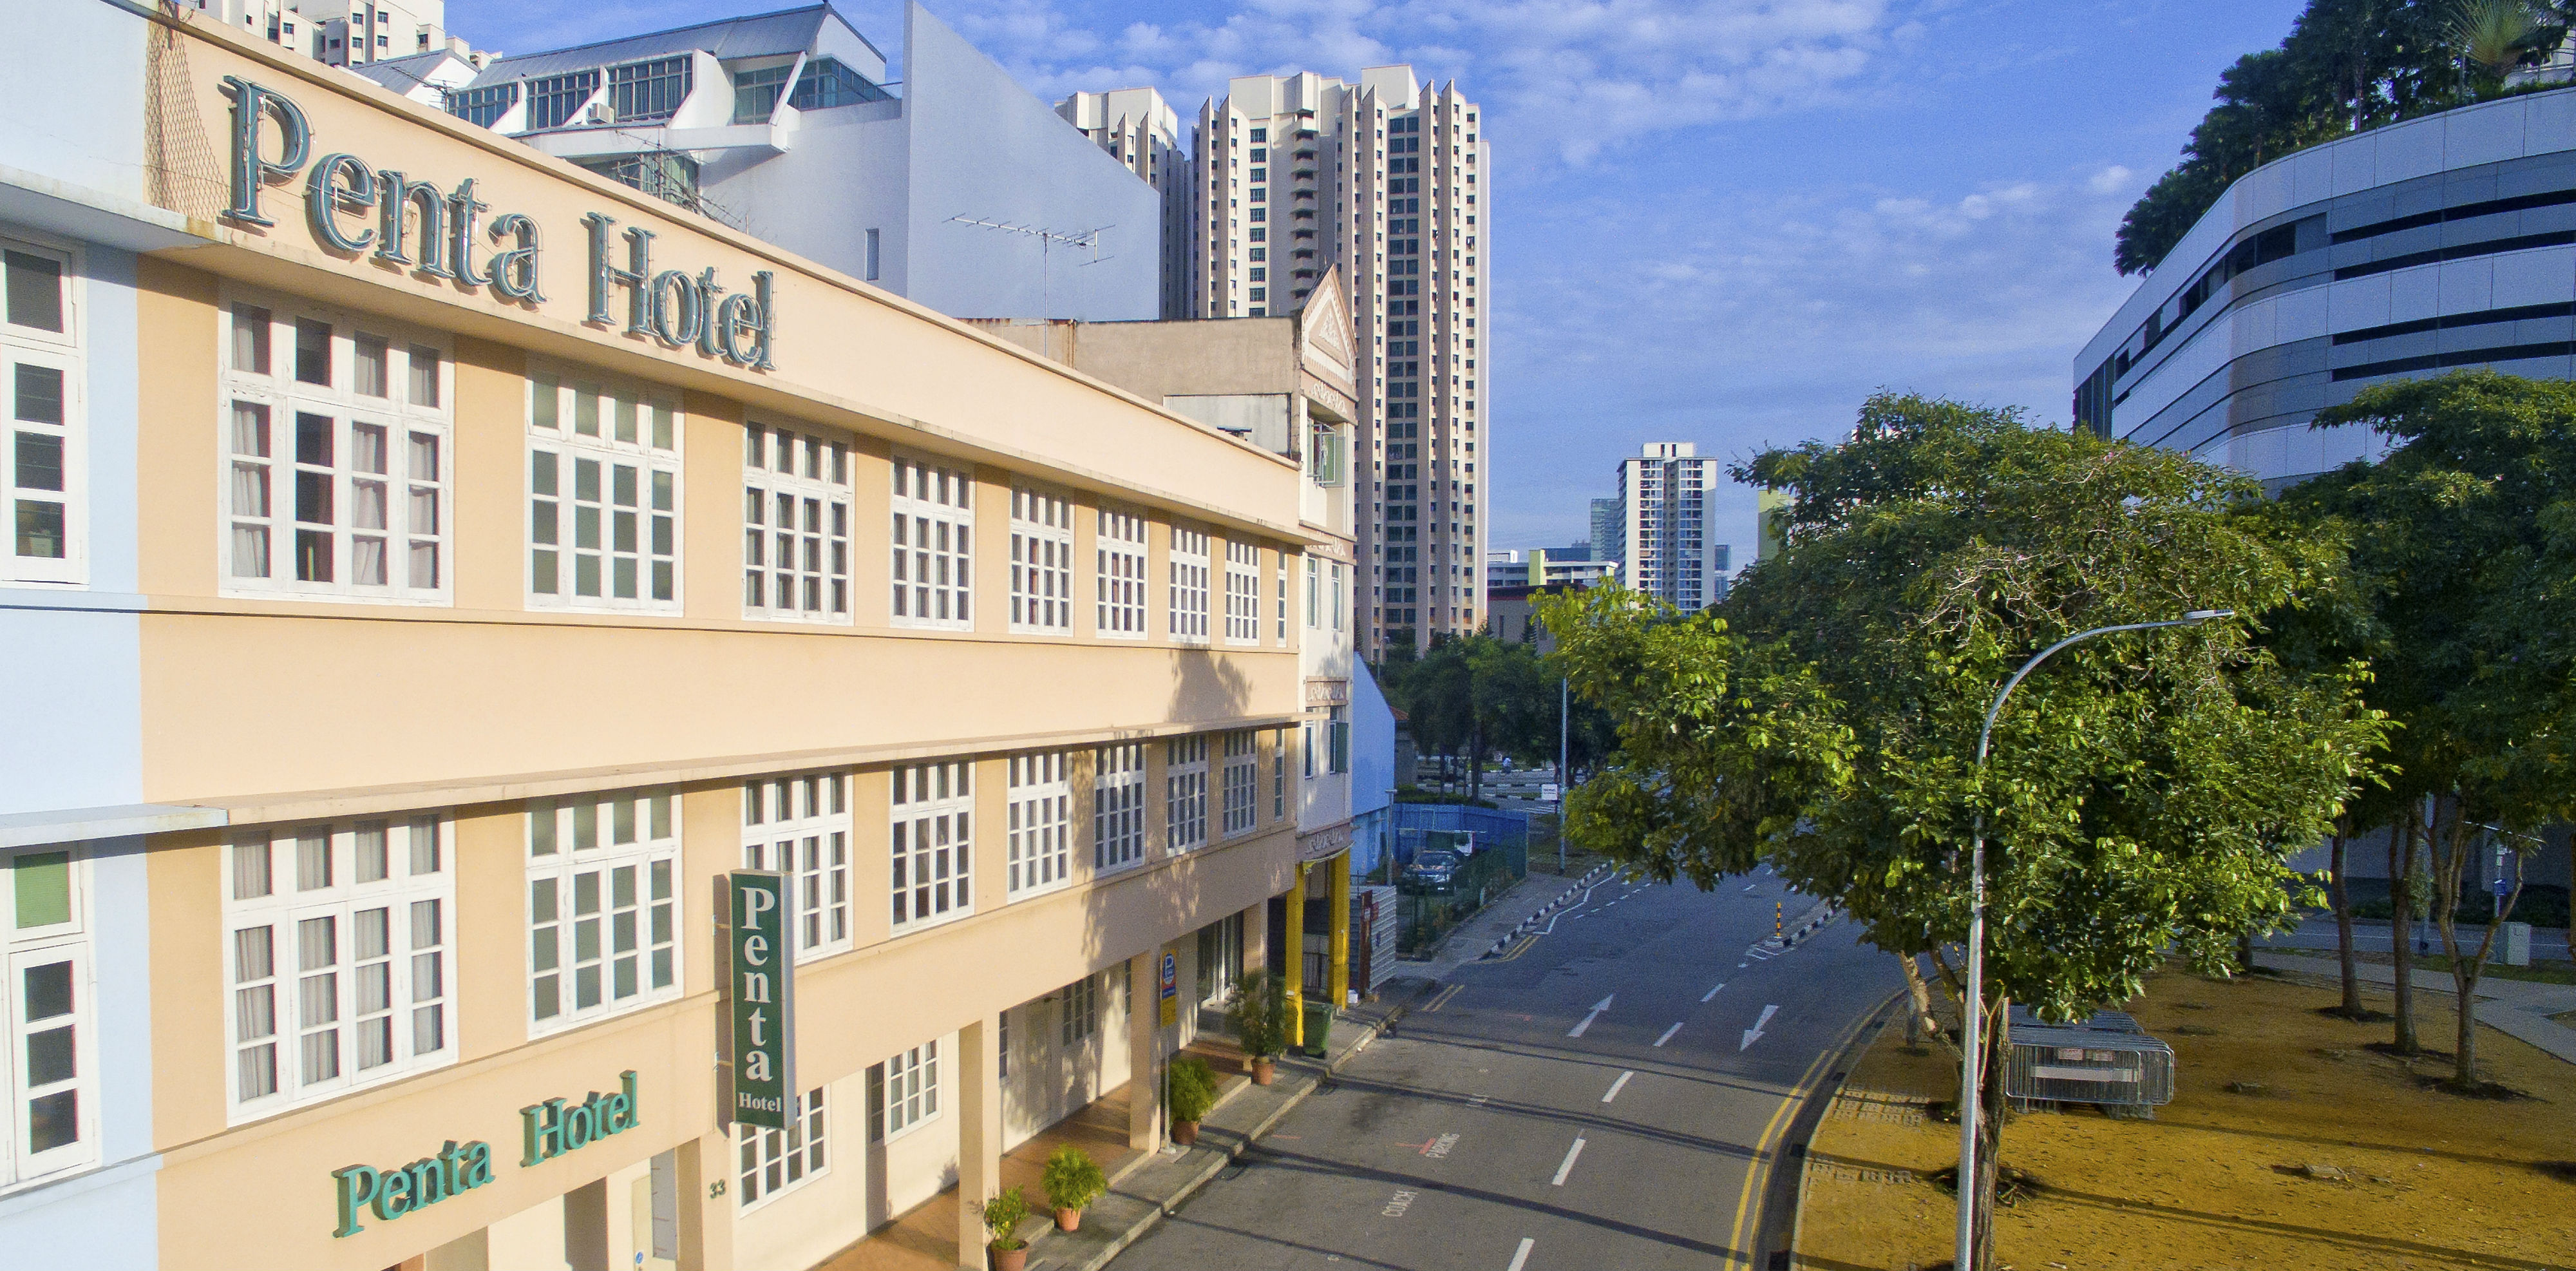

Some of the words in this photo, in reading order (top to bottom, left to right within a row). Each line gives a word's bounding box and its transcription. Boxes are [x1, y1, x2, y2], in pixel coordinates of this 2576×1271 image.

[222, 75, 548, 304] Penta
[586, 211, 778, 371] Hotel
[740, 887, 775, 1082] Penta
[331, 1140, 496, 1238] Penta
[519, 1069, 641, 1167] Hotel
[738, 1092, 782, 1113] Hotel
[709, 1178, 726, 1199] 33
